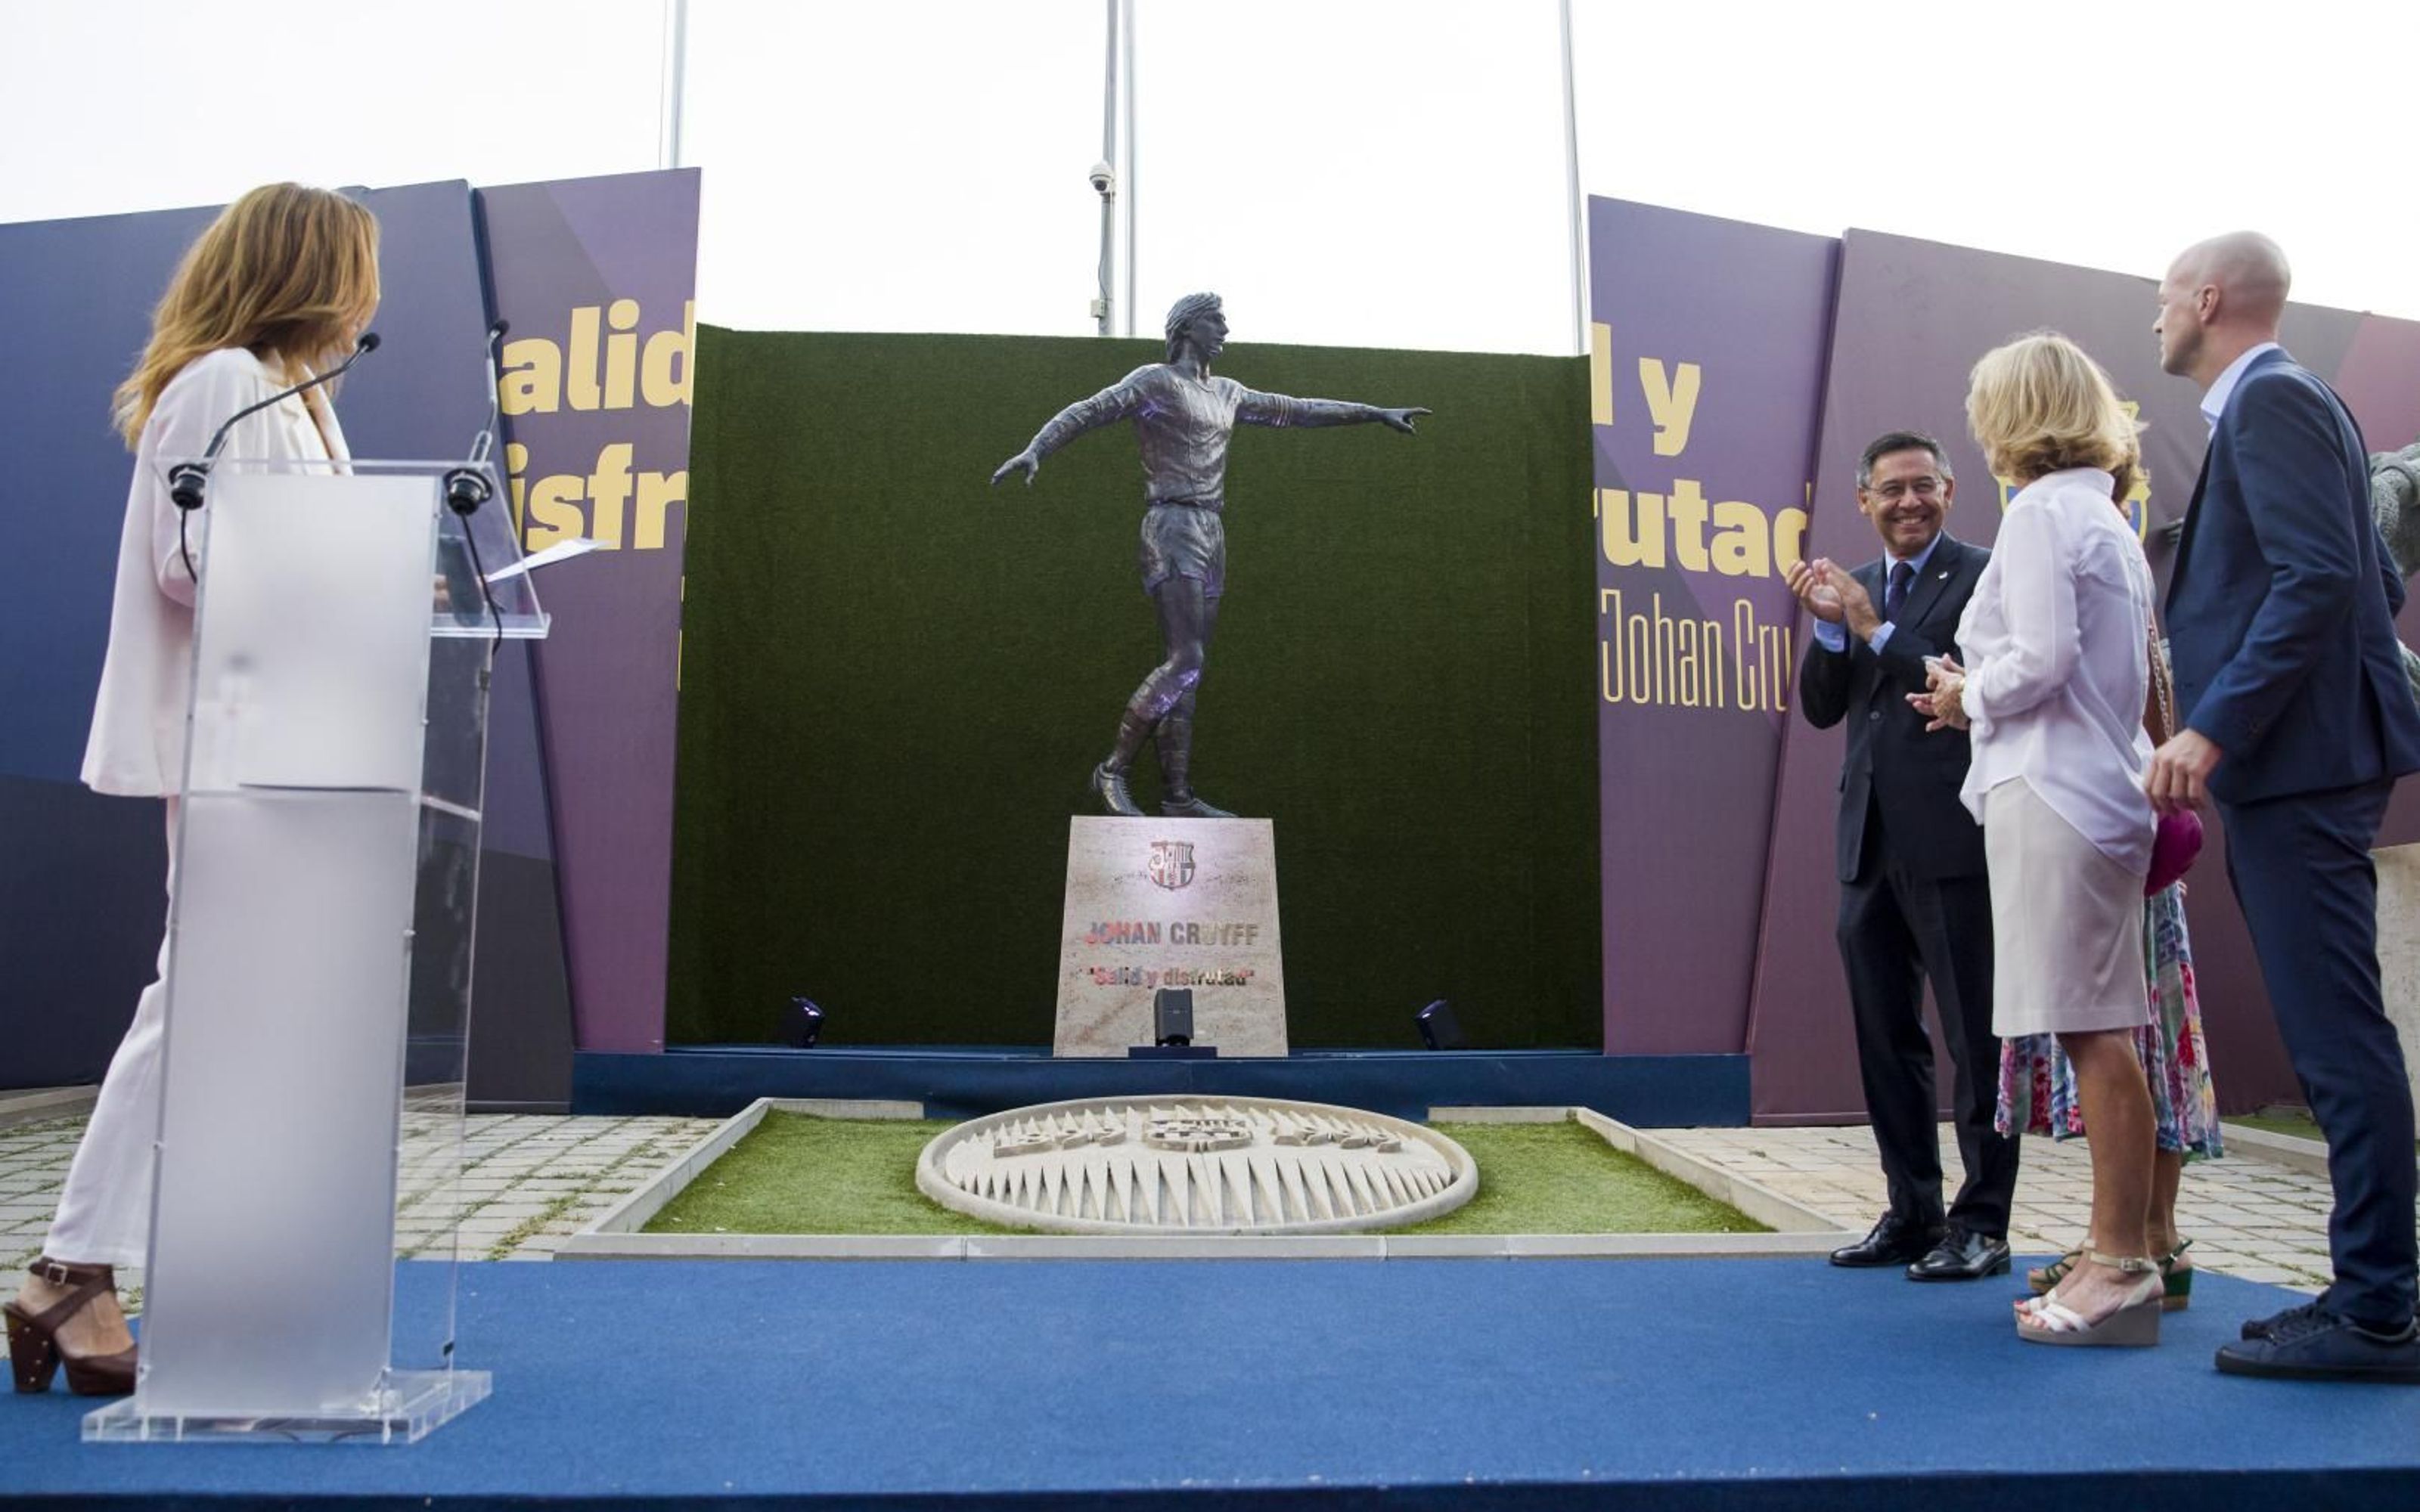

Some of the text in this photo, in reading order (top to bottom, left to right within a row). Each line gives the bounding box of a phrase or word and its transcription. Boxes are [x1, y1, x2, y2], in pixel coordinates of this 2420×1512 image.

[1639, 357, 1701, 456] y
[1601, 588, 1723, 708] Johan
[1083, 921, 1258, 945] JOHAN CRUYFF
[1146, 968, 1159, 989] y
